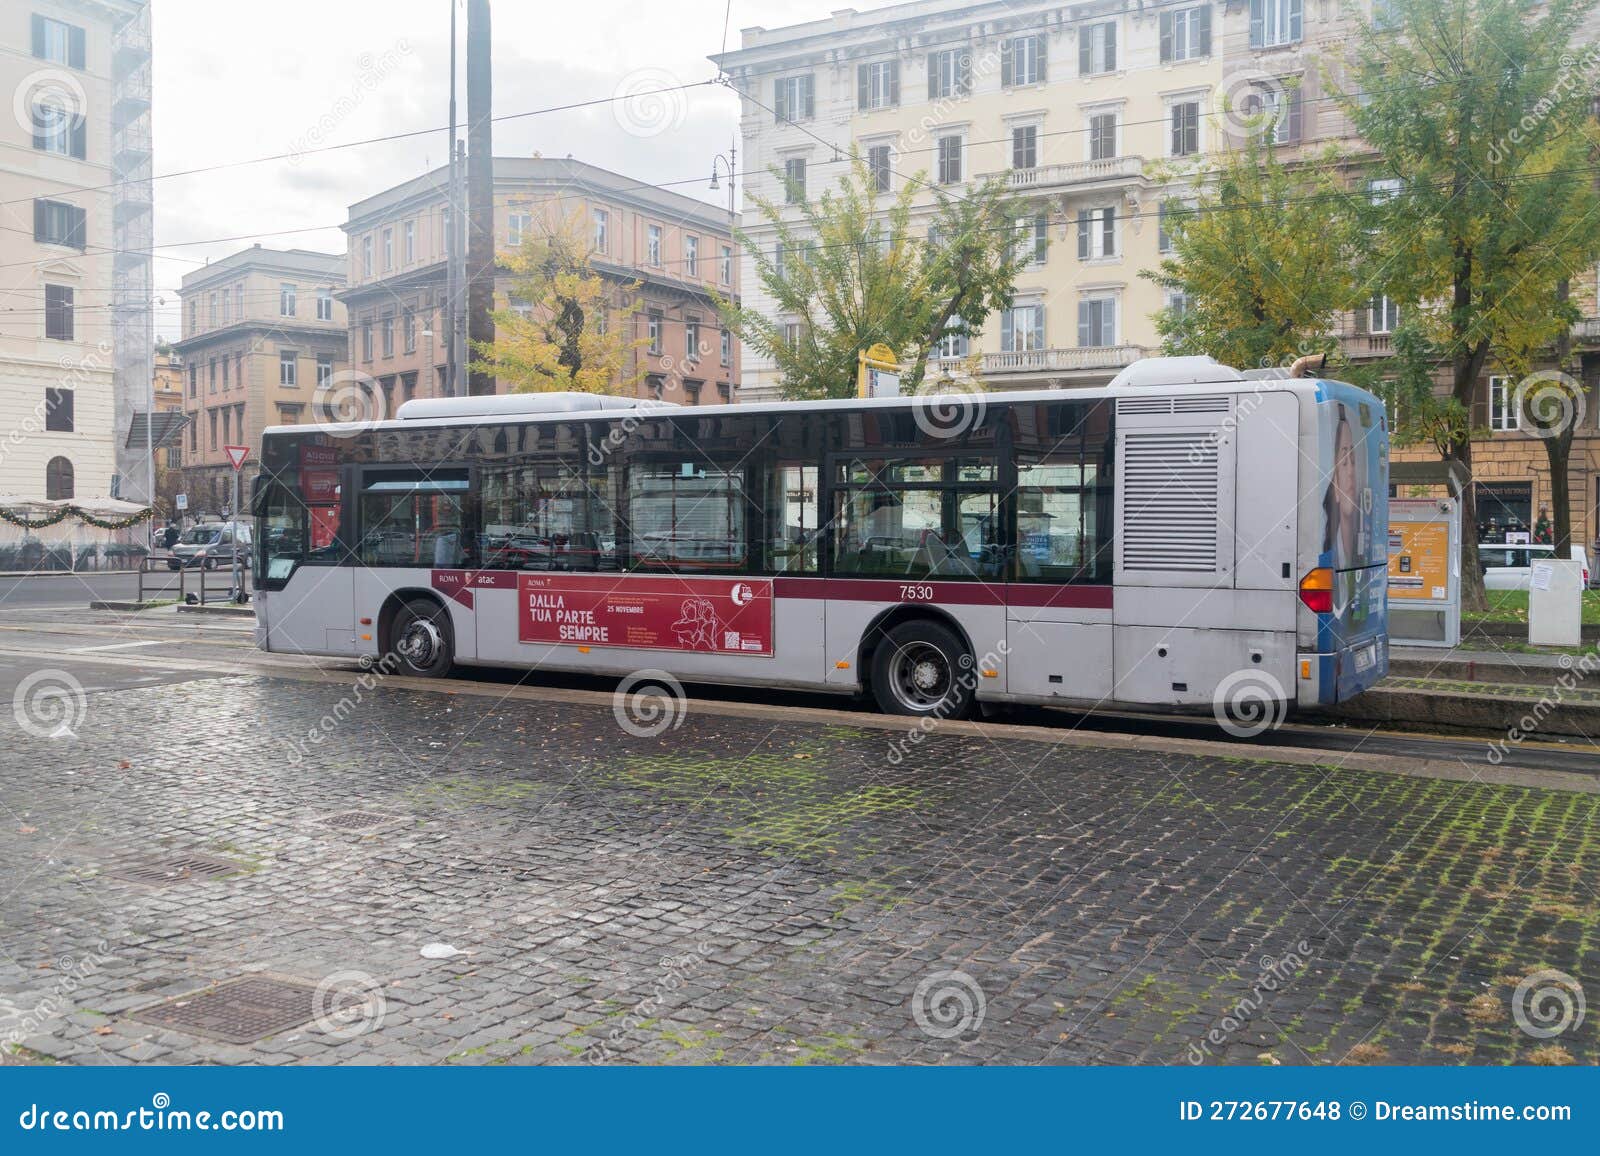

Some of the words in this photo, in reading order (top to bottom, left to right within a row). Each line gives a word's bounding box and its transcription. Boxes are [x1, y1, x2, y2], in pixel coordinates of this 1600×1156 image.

[478, 575, 495, 584] atac
[899, 585, 933, 600] 7530
[529, 594, 565, 608] DALLA
[530, 609, 552, 622] TUA
[560, 625, 609, 642] SEMPRE
